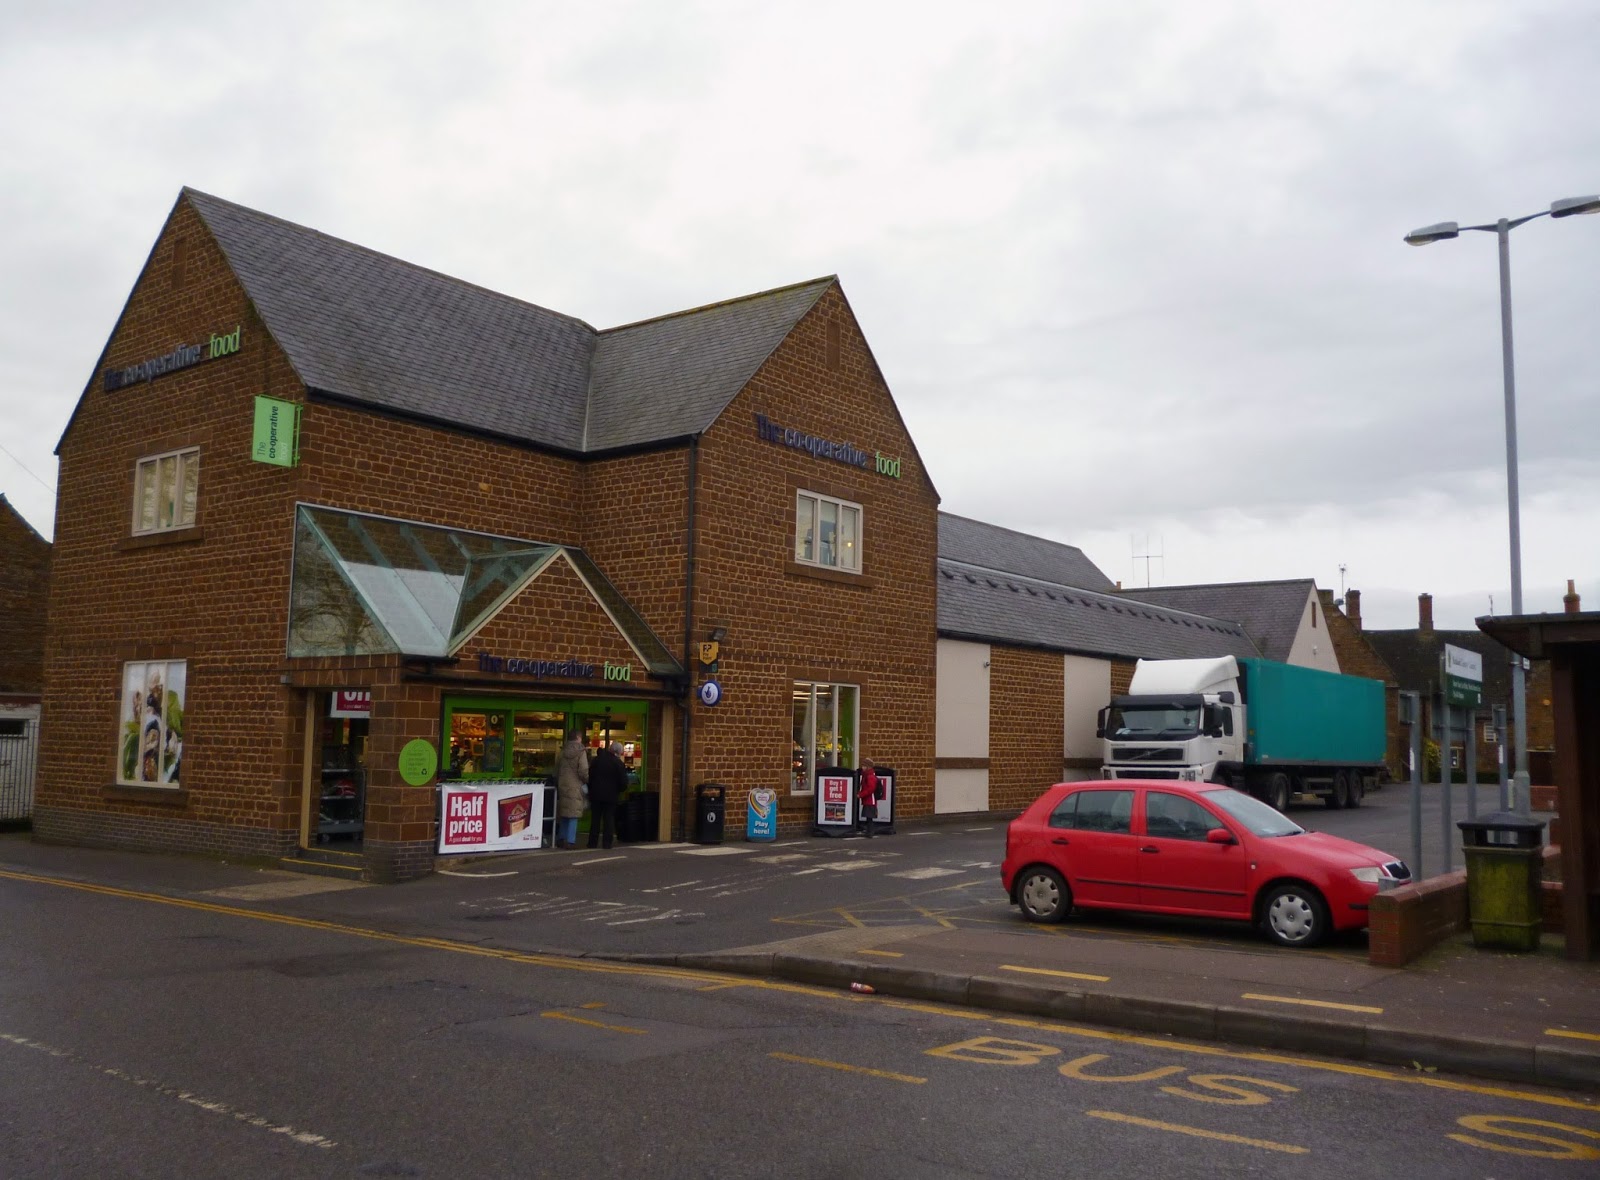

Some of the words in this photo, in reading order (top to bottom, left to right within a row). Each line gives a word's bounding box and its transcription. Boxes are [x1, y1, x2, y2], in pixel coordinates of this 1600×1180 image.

[209, 325, 240, 358] food
[269, 406, 279, 458] co-operative
[257, 441, 267, 456] The
[784, 428, 867, 467] co-operative
[875, 451, 900, 478] food
[507, 658, 594, 679] co-operative
[603, 661, 631, 682] food
[451, 796, 483, 816] Half
[449, 817, 482, 836] price
[755, 820, 769, 828] Play
[924, 1035, 1300, 1106] BUS
